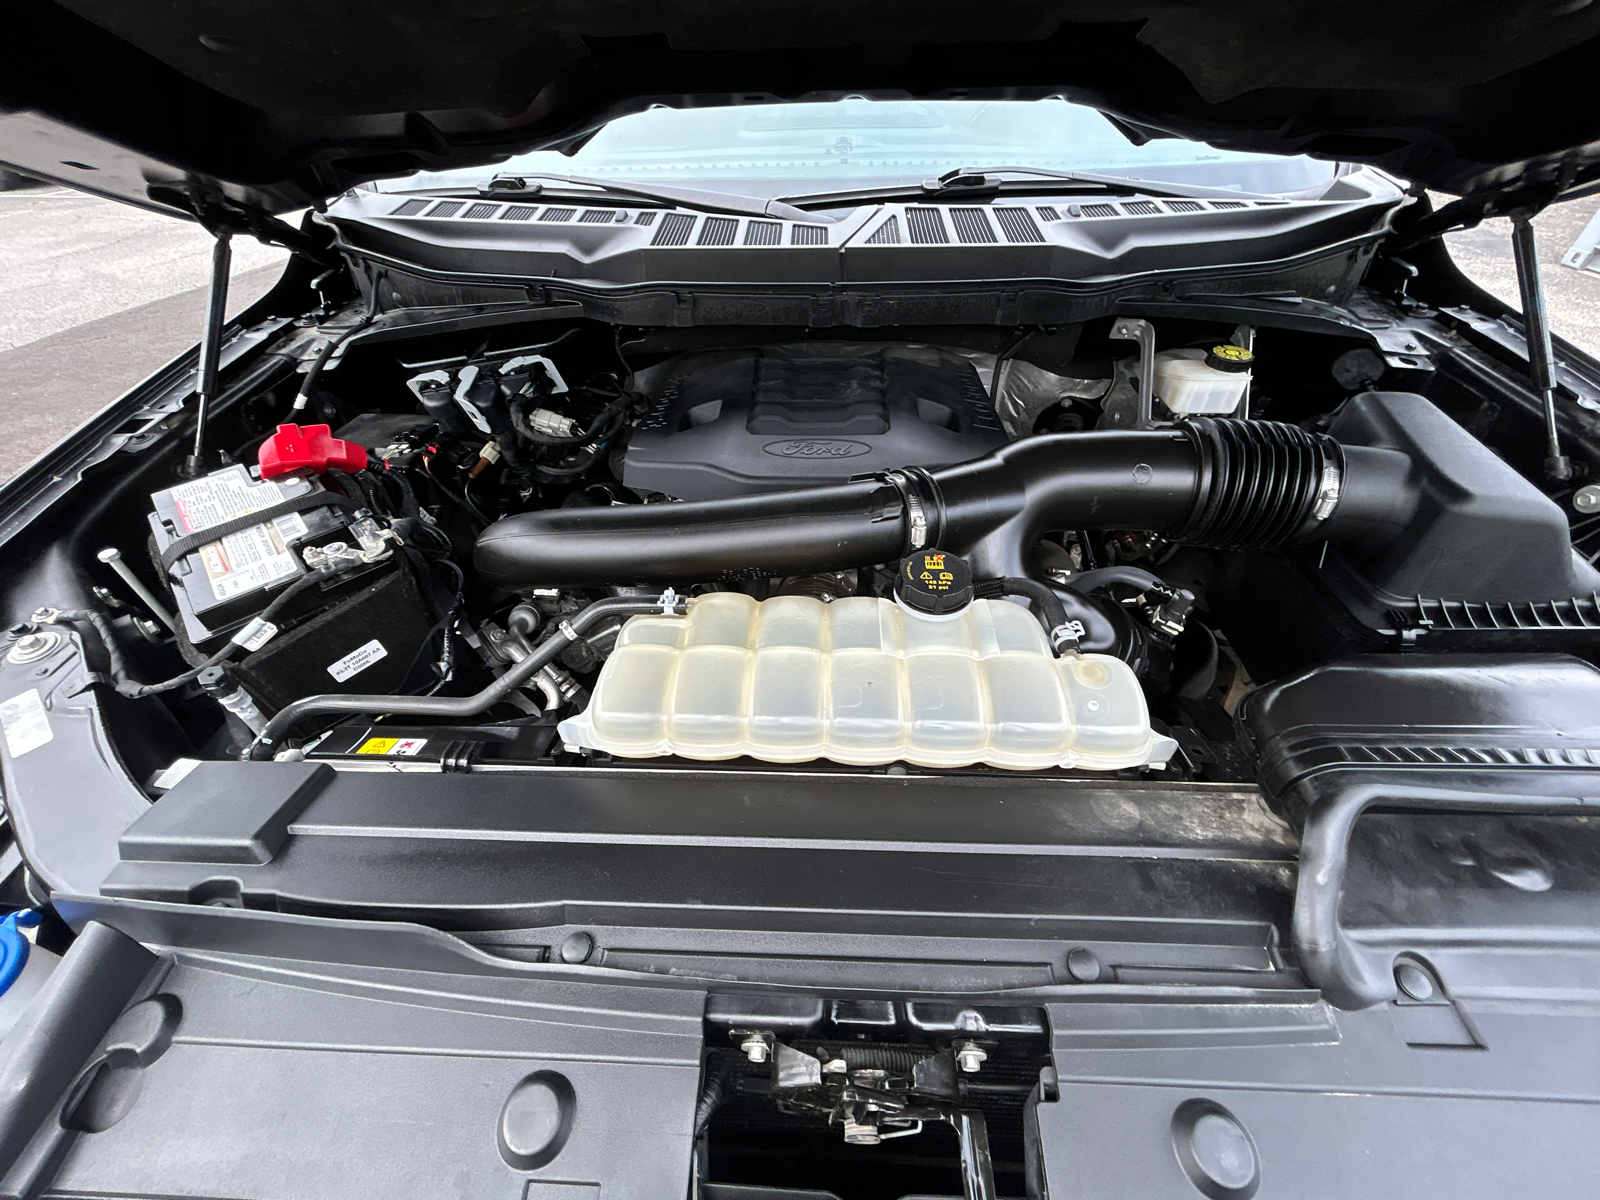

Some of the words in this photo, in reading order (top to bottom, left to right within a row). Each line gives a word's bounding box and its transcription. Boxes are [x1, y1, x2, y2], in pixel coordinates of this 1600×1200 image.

[782, 441, 853, 456] Ford
[206, 545, 226, 574] ACDelco
[343, 650, 367, 665] FoMoCo
[372, 647, 381, 655] AA
